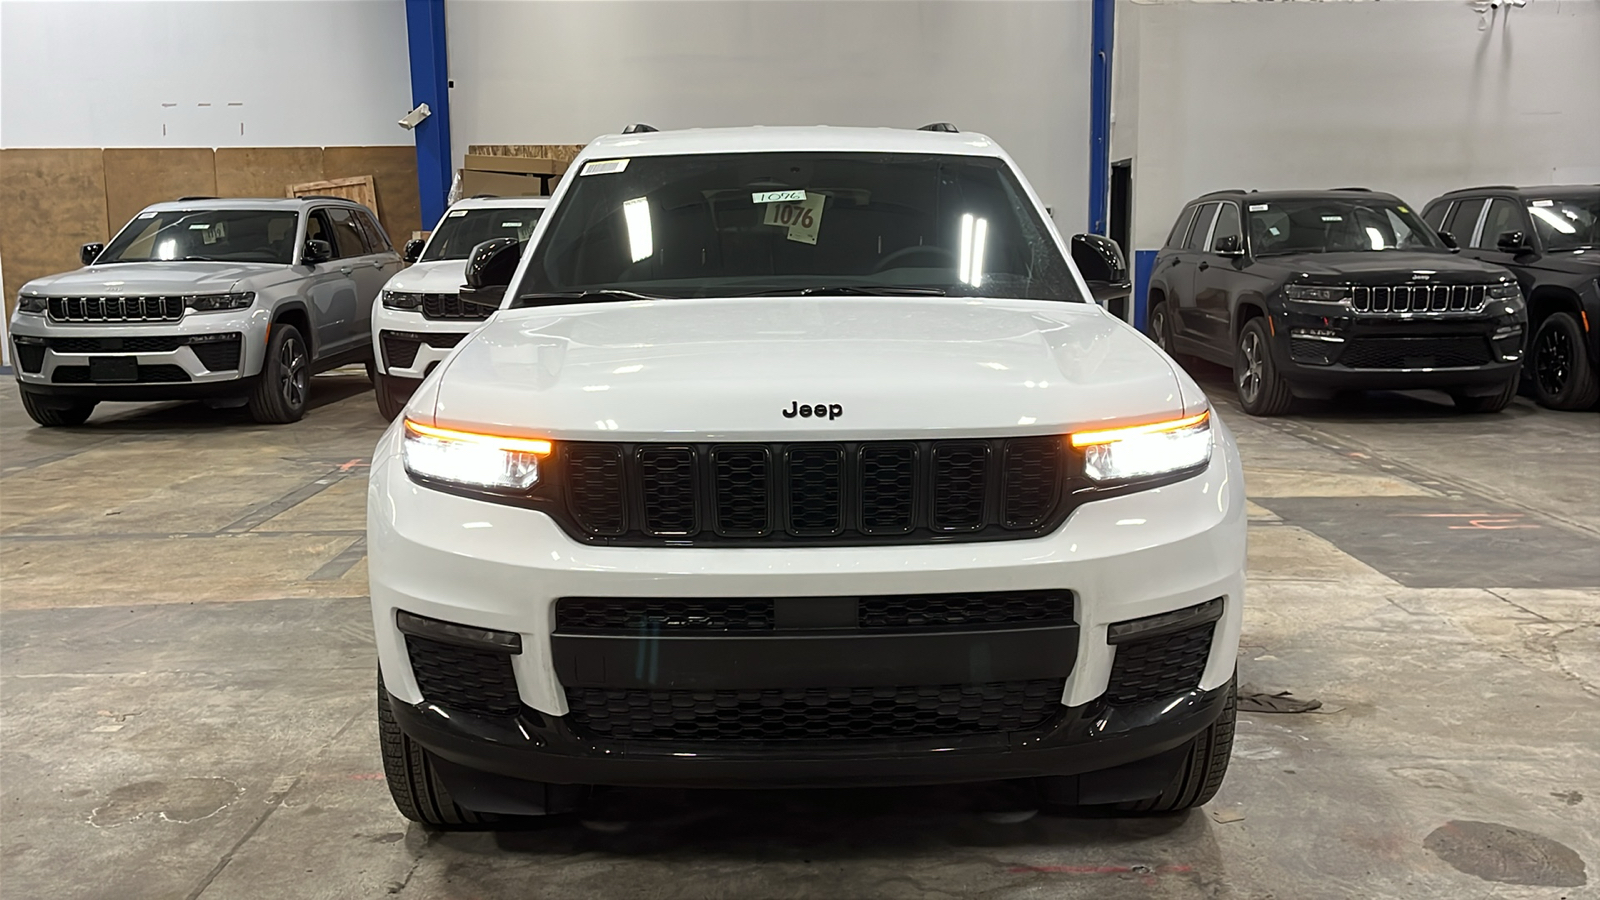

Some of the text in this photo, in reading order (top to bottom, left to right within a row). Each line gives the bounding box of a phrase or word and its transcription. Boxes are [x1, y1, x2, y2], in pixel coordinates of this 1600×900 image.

[761, 192, 800, 202] 1076
[773, 203, 814, 229] 1076
[782, 401, 843, 420] Jeep
